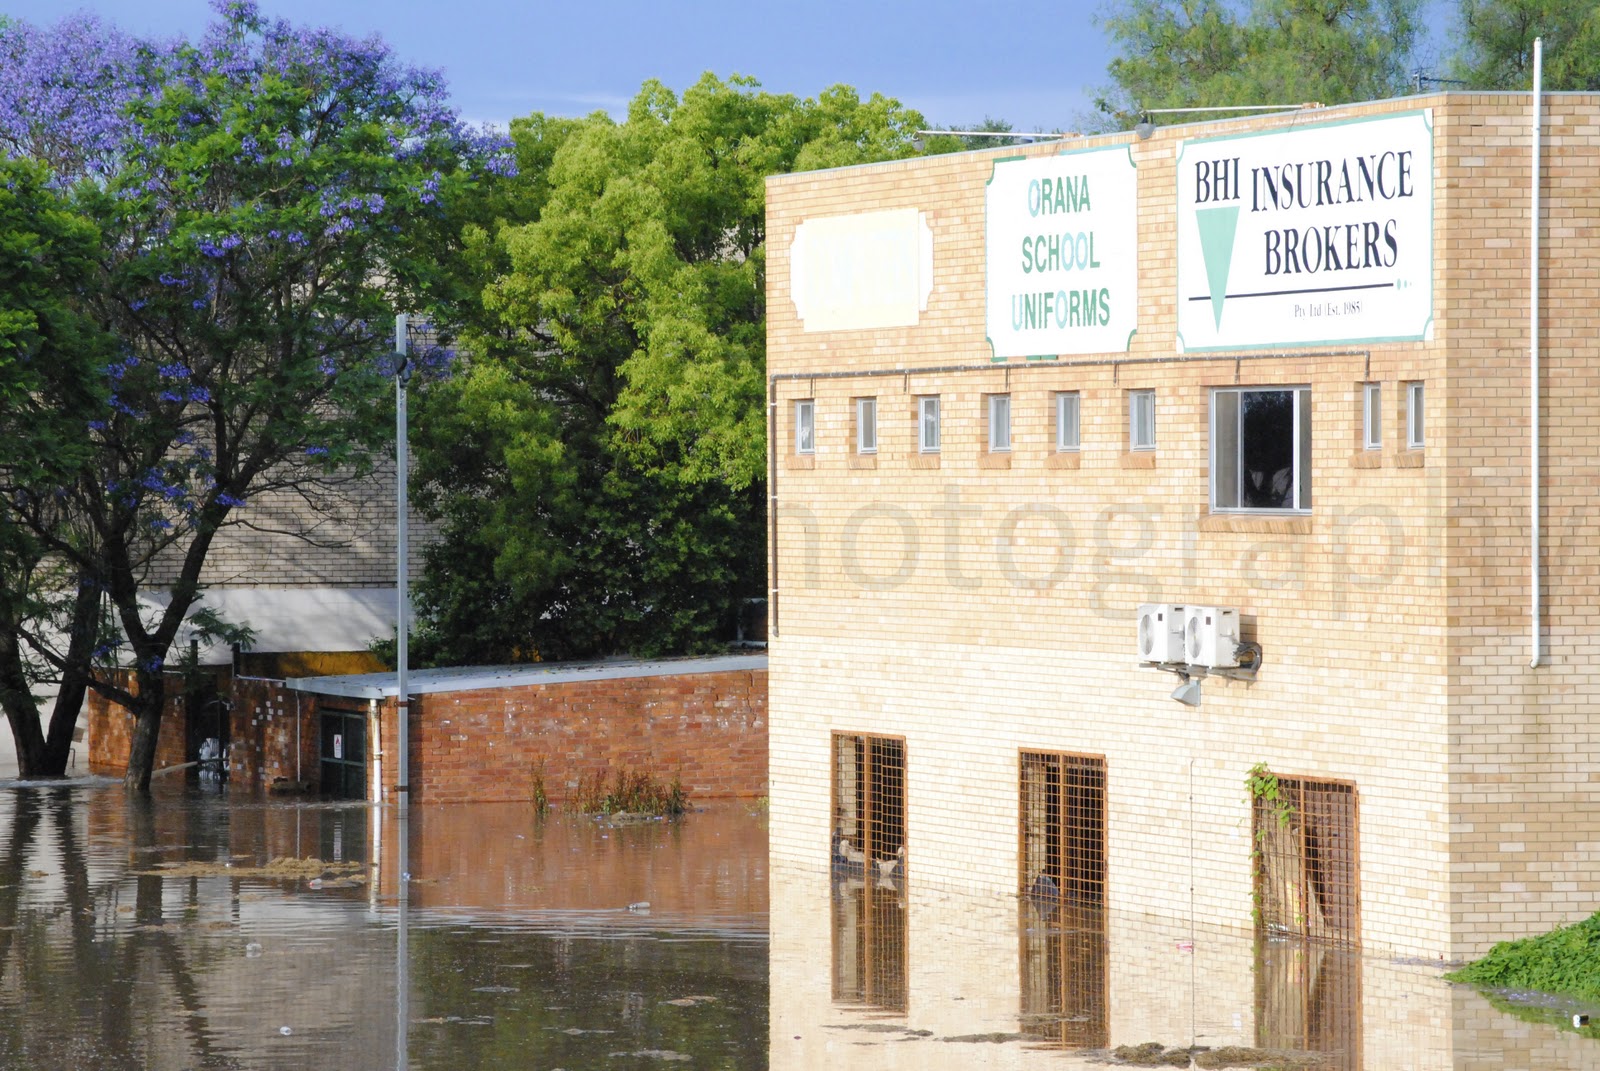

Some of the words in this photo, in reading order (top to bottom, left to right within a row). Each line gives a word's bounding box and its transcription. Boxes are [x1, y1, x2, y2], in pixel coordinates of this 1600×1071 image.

[1029, 175, 1090, 217] ORANA
[1195, 157, 1240, 203] BHI
[1251, 151, 1413, 212] INSURANCE
[1022, 232, 1100, 274] SCHOOL
[1264, 219, 1397, 275] BROKERS
[1012, 288, 1110, 331] UNIFORMS
[1294, 304, 1306, 320] Pty
[1310, 303, 1322, 318] Ltd
